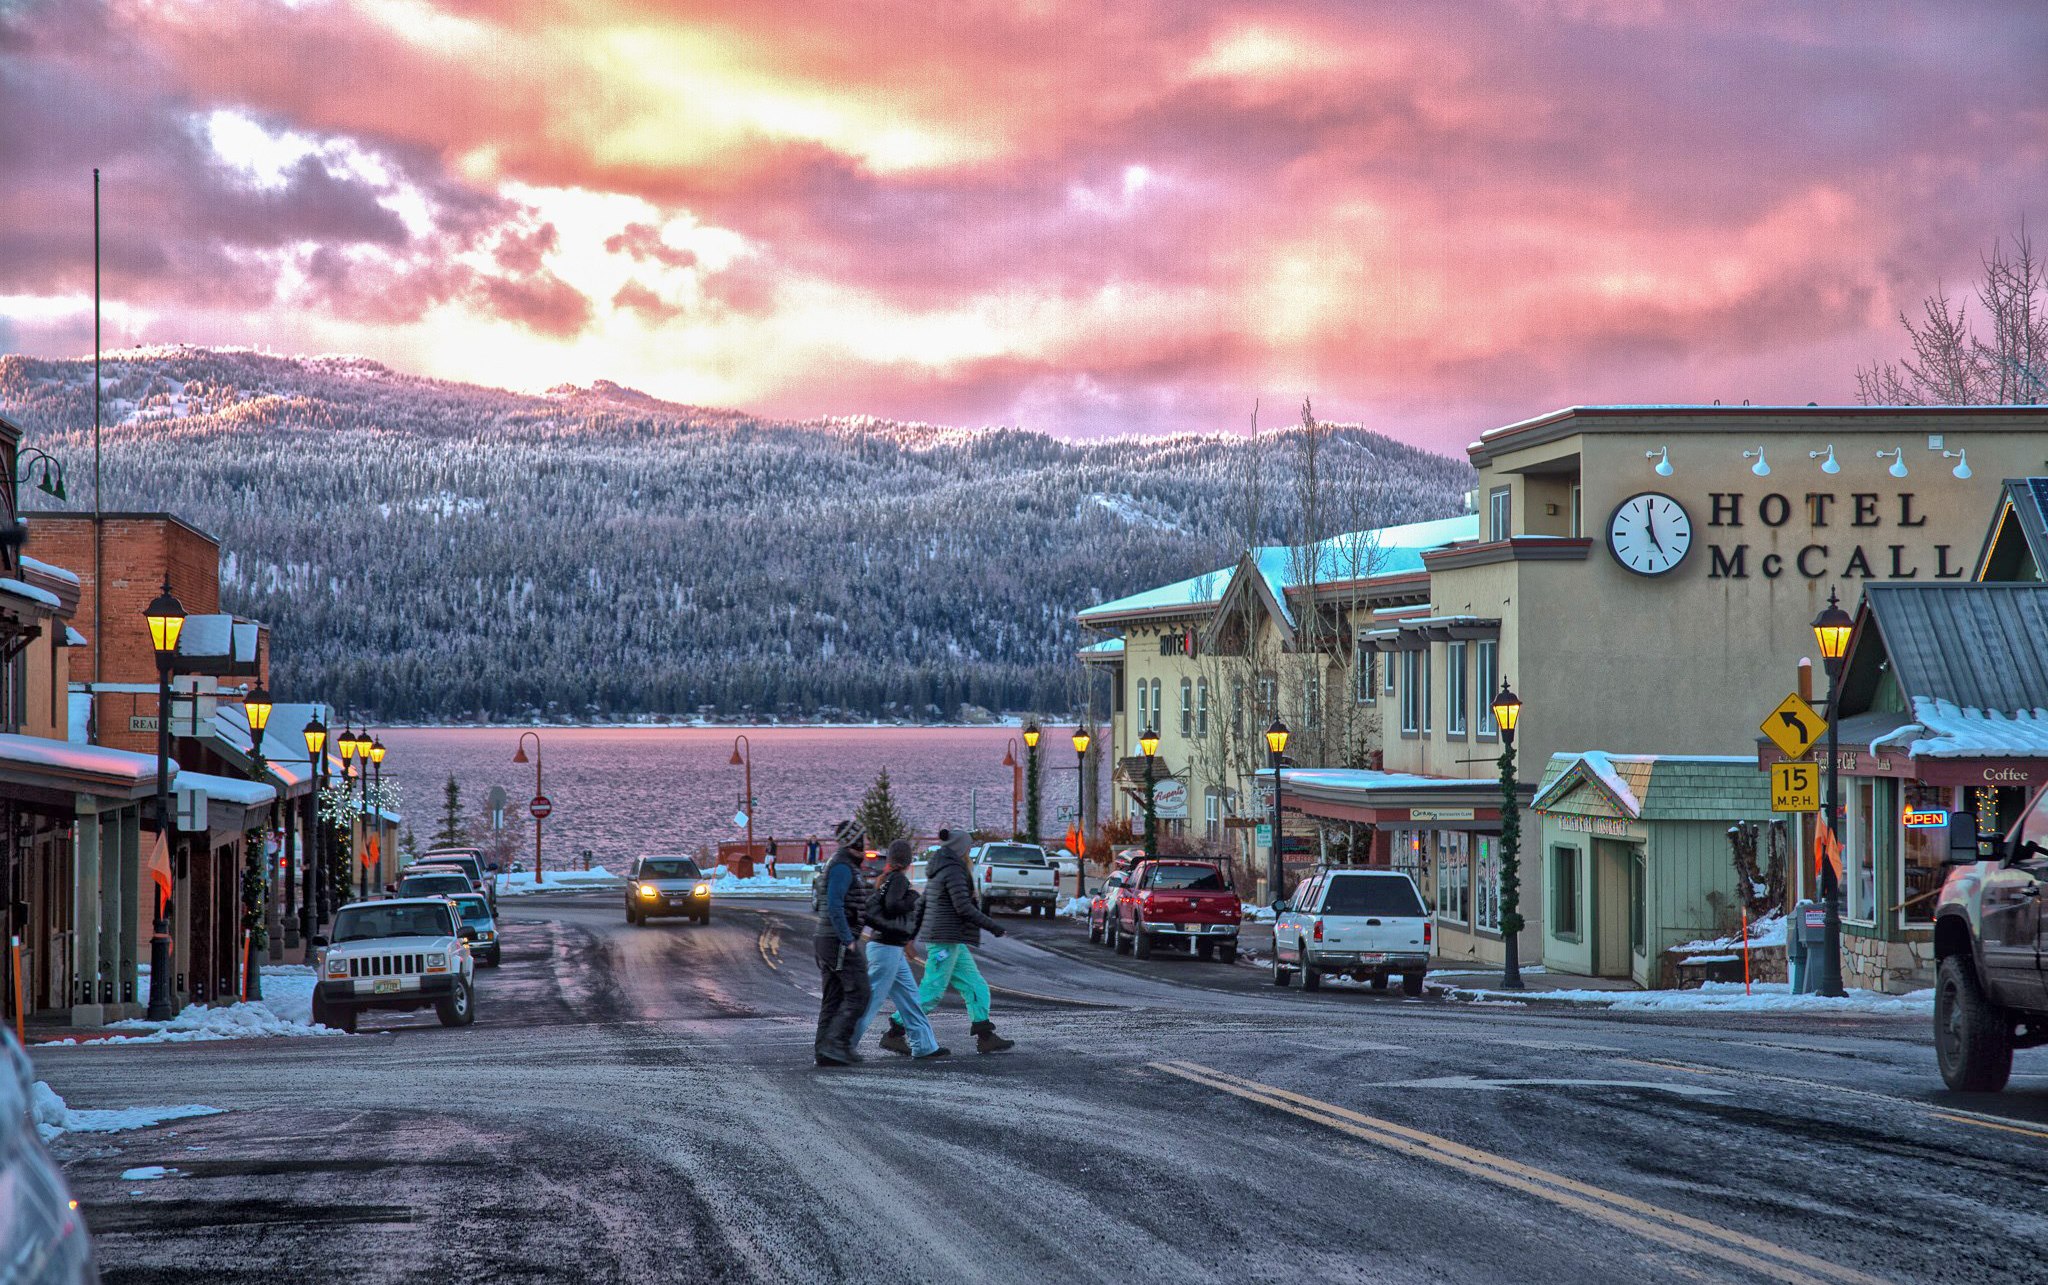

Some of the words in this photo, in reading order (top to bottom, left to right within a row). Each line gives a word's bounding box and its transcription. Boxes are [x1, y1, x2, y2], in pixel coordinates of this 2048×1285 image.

[1707, 493, 1927, 527] HOTEL
[1707, 544, 1963, 579] McCALL
[1160, 634, 1186, 656] HOTE
[1783, 768, 1808, 791] 15
[1983, 767, 2028, 781] Coffee
[1777, 796, 1814, 806] M.P.H.
[1903, 813, 1943, 825] OPEN
